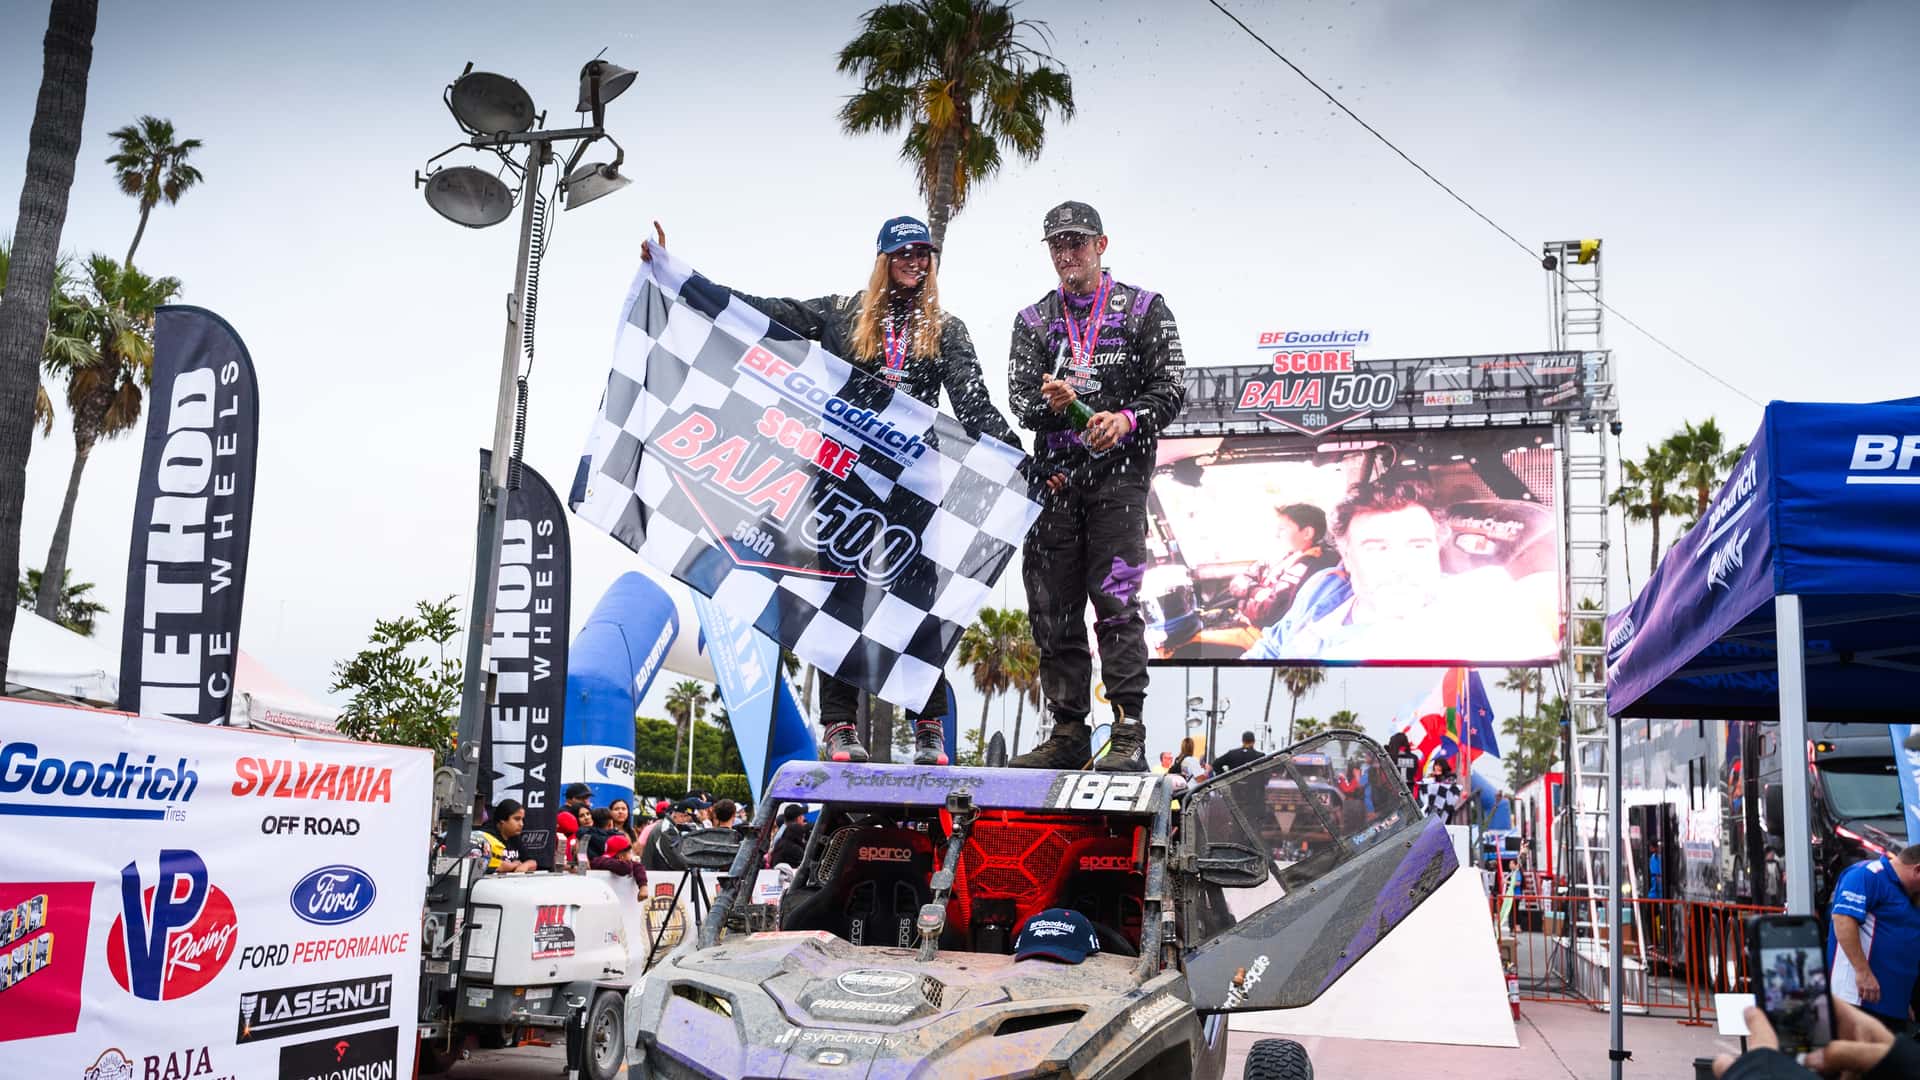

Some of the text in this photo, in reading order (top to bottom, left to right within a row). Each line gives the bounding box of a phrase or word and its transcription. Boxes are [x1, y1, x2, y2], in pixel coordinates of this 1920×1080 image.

[1259, 330, 1370, 345] BFGoodrich
[1273, 351, 1355, 374] SCORE
[742, 344, 927, 461] BFGoodrich
[1238, 374, 1396, 410] BAJA 500
[1302, 413, 1328, 427] 56th
[756, 407, 861, 481] SCORE
[210, 359, 241, 595] WHEELS
[654, 411, 921, 586] BAJA 500
[731, 518, 776, 558] 56th
[533, 518, 554, 681] WHEELS
[491, 518, 534, 808] METHOD
[0, 742, 199, 802] Goodrich
[527, 706, 550, 809] RACE
[231, 756, 393, 803] SYLVANIA
[1054, 774, 1160, 812] 1821
[165, 805, 187, 822] Tires
[260, 816, 361, 836] OFF ROAD
[858, 846, 912, 861] sparco
[308, 873, 361, 914] Ford
[120, 849, 210, 1001] VP
[167, 920, 239, 982] Racing
[239, 932, 410, 971] FORD PERFORMANCE
[258, 980, 392, 1023] LASERNUT
[810, 999, 916, 1015] PROGRESSIVE
[801, 1032, 901, 1048] synchrony
